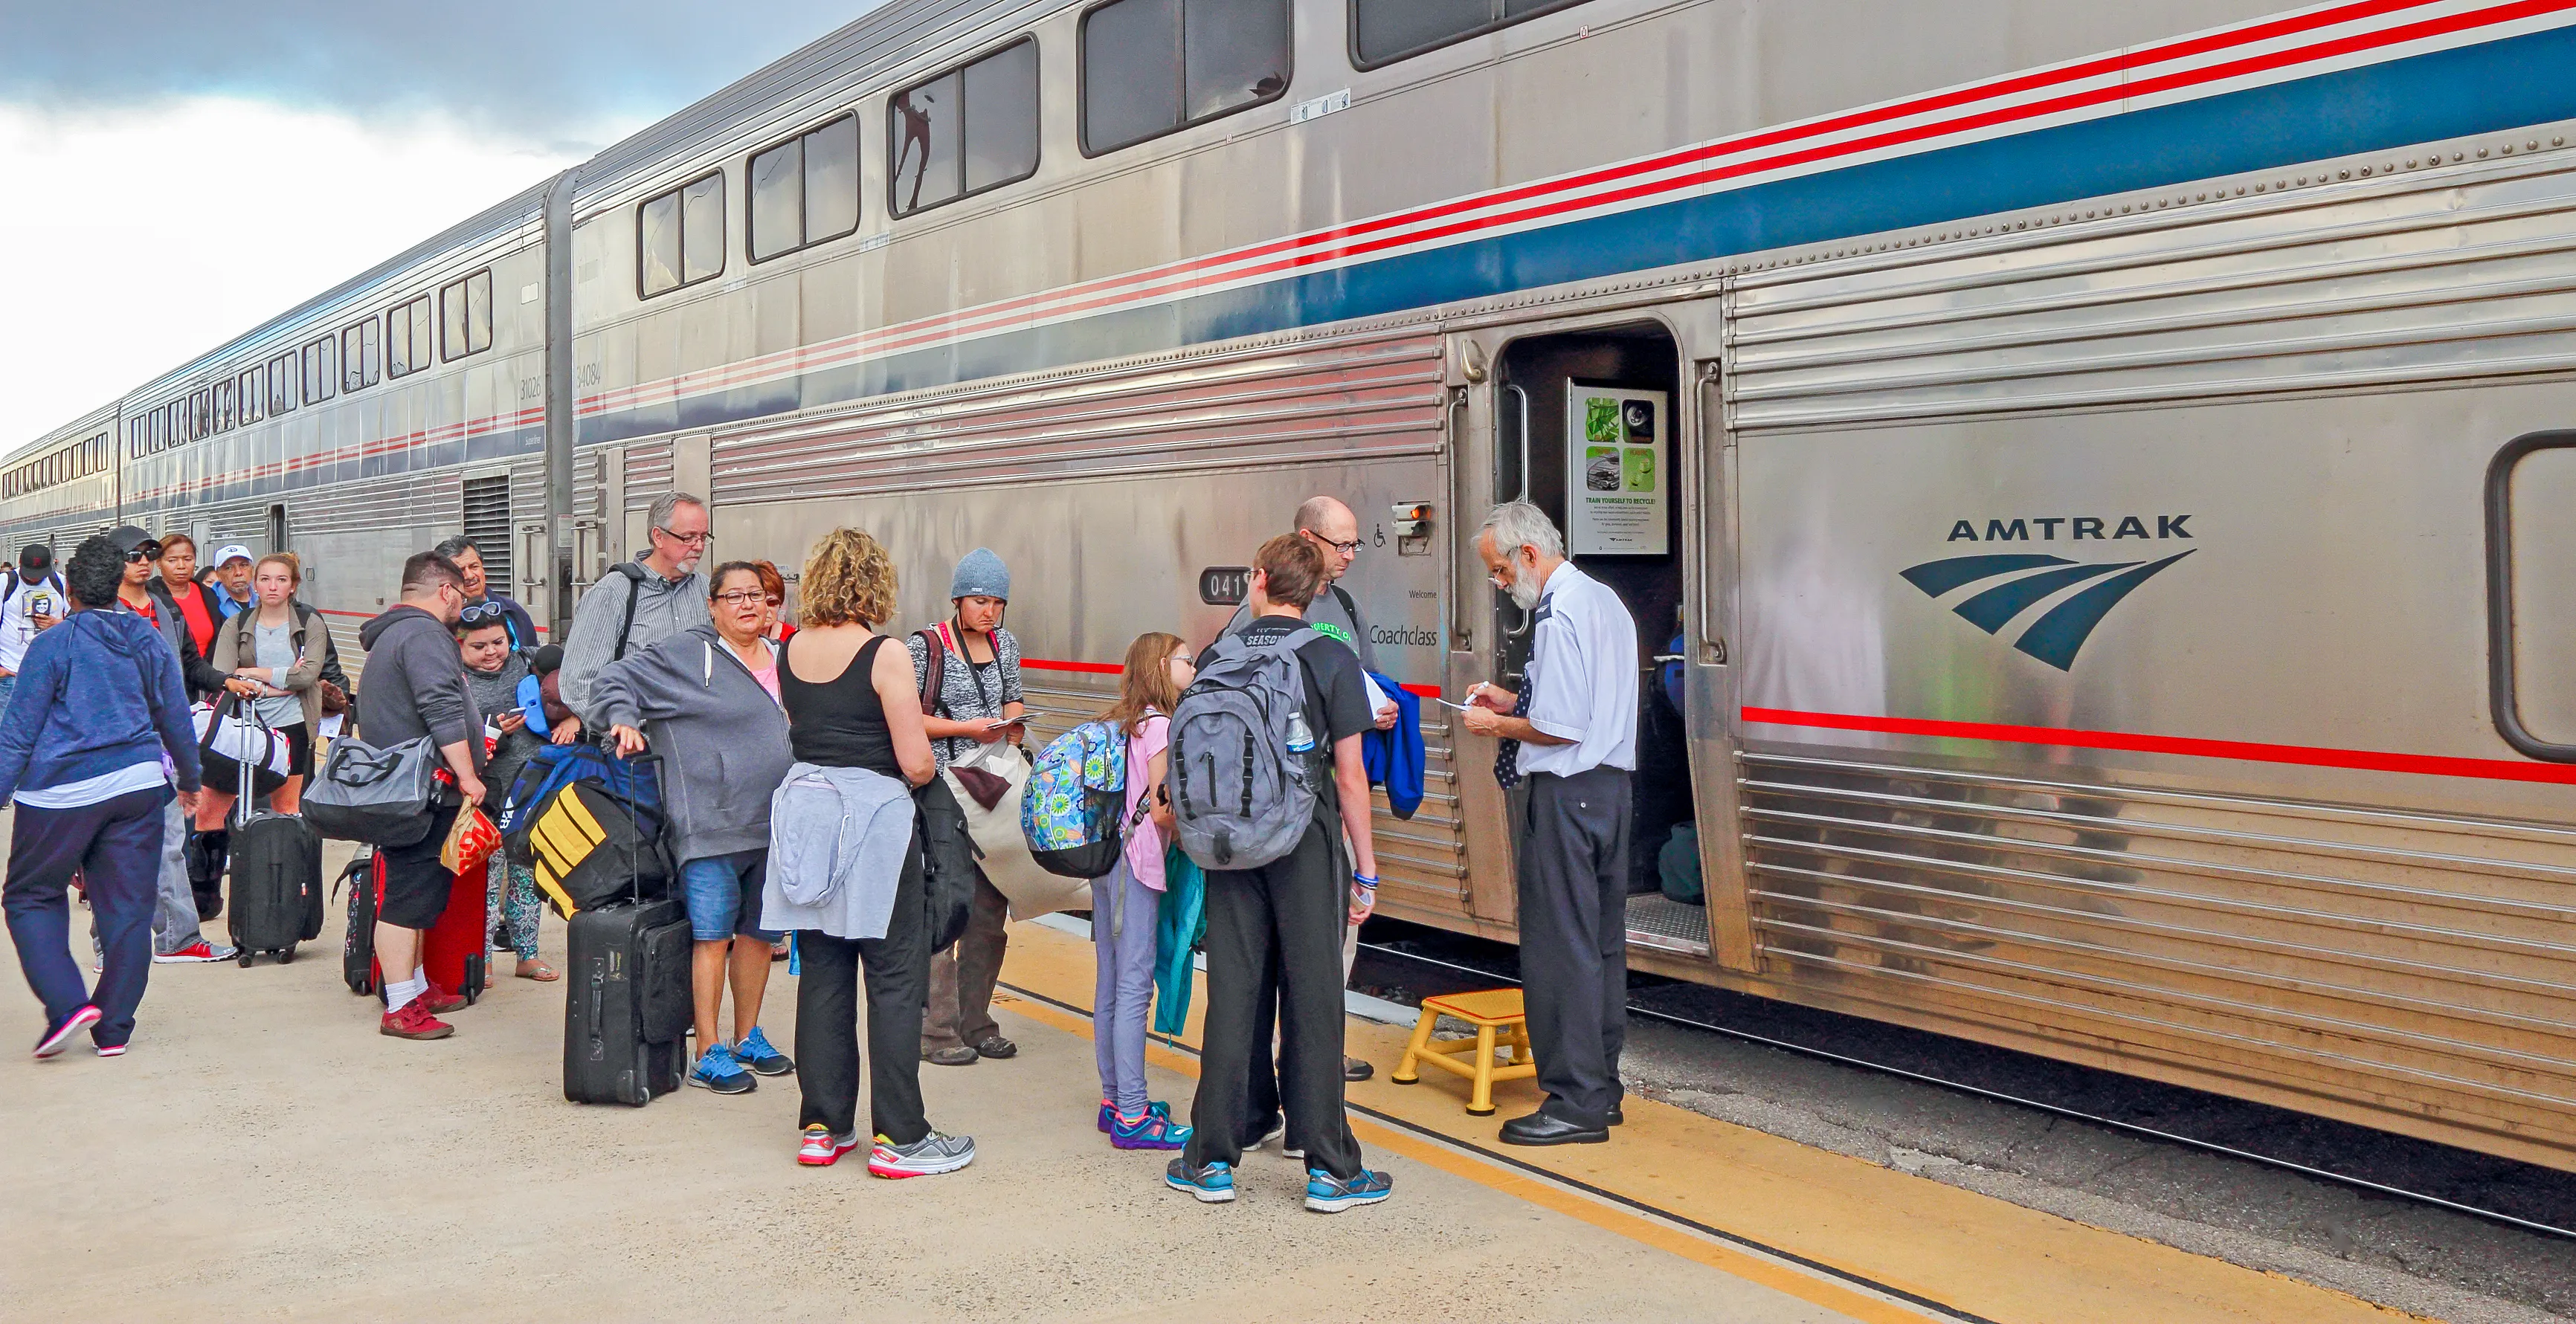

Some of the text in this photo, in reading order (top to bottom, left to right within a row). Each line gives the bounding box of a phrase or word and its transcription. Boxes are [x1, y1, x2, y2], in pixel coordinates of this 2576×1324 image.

[577, 362, 601, 389] 34084
[521, 376, 541, 400] 31026
[1947, 514, 2193, 542] AMTRAK
[1408, 590, 1437, 598] Welcome
[1370, 624, 1437, 646] Coachclass
